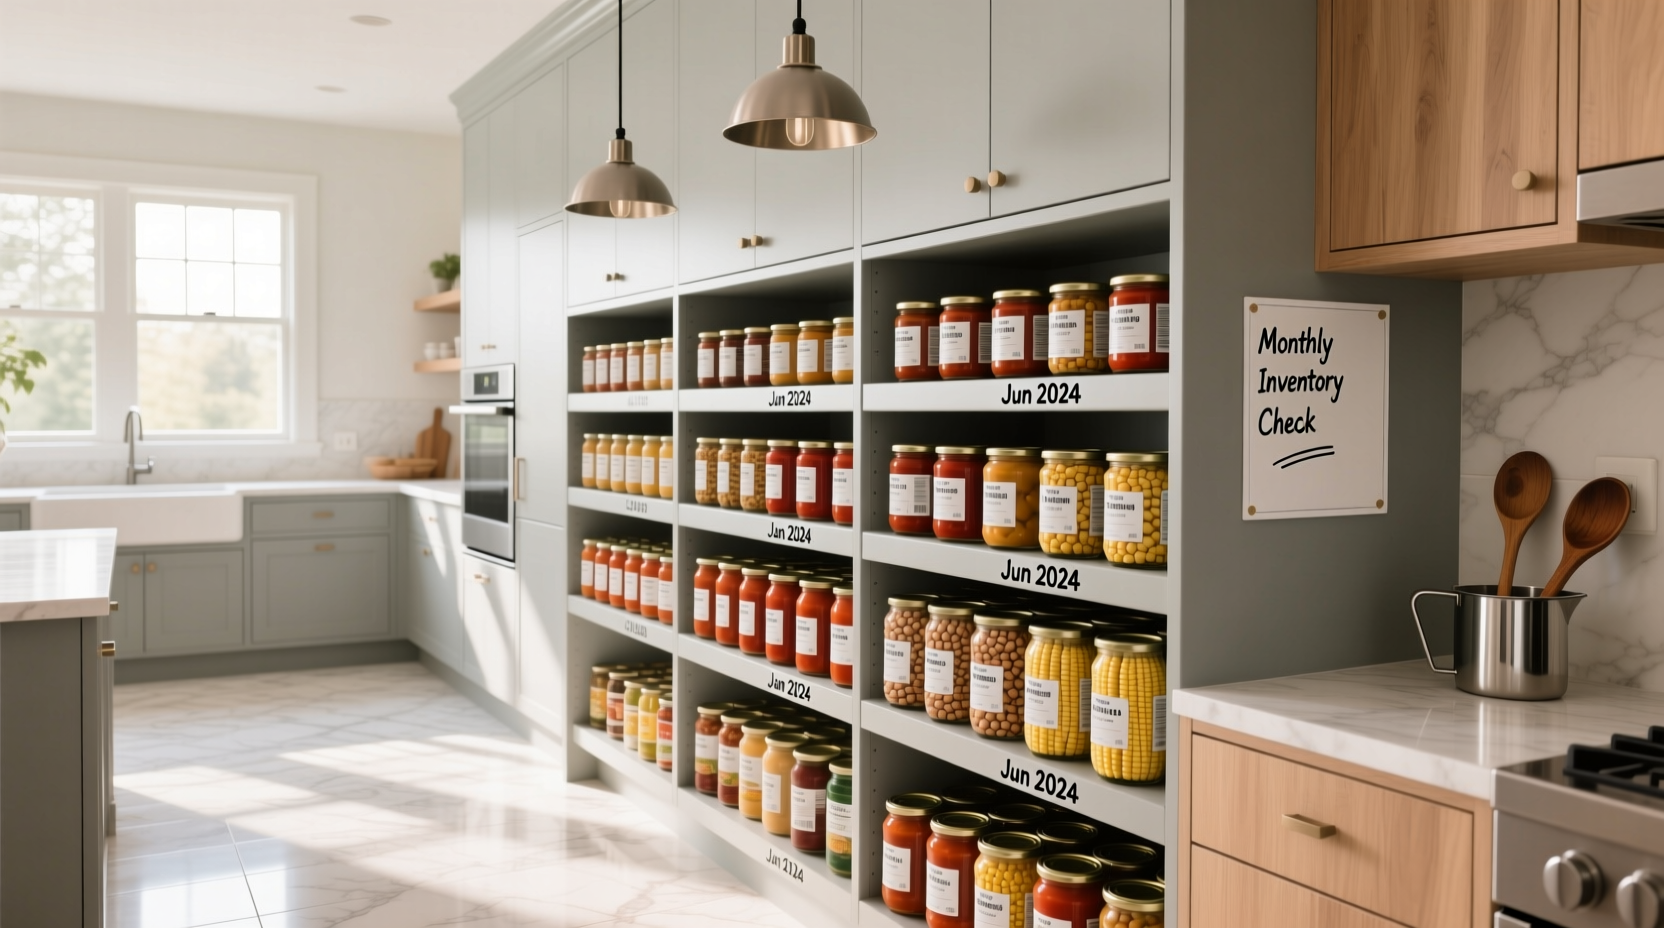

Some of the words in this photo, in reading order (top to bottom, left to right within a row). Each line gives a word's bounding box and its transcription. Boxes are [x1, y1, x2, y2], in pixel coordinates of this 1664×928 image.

[1257, 326, 1334, 366] Monthly
[1000, 383, 1033, 405] Jun
[1036, 382, 1082, 405] 2024
[1257, 367, 1345, 404] Inventory
[1257, 405, 1317, 437] Check
[1000, 558, 1032, 584] Jun
[1035, 563, 1081, 592] 2024
[1000, 758, 1030, 788] Jun
[1033, 769, 1080, 805] 2024
